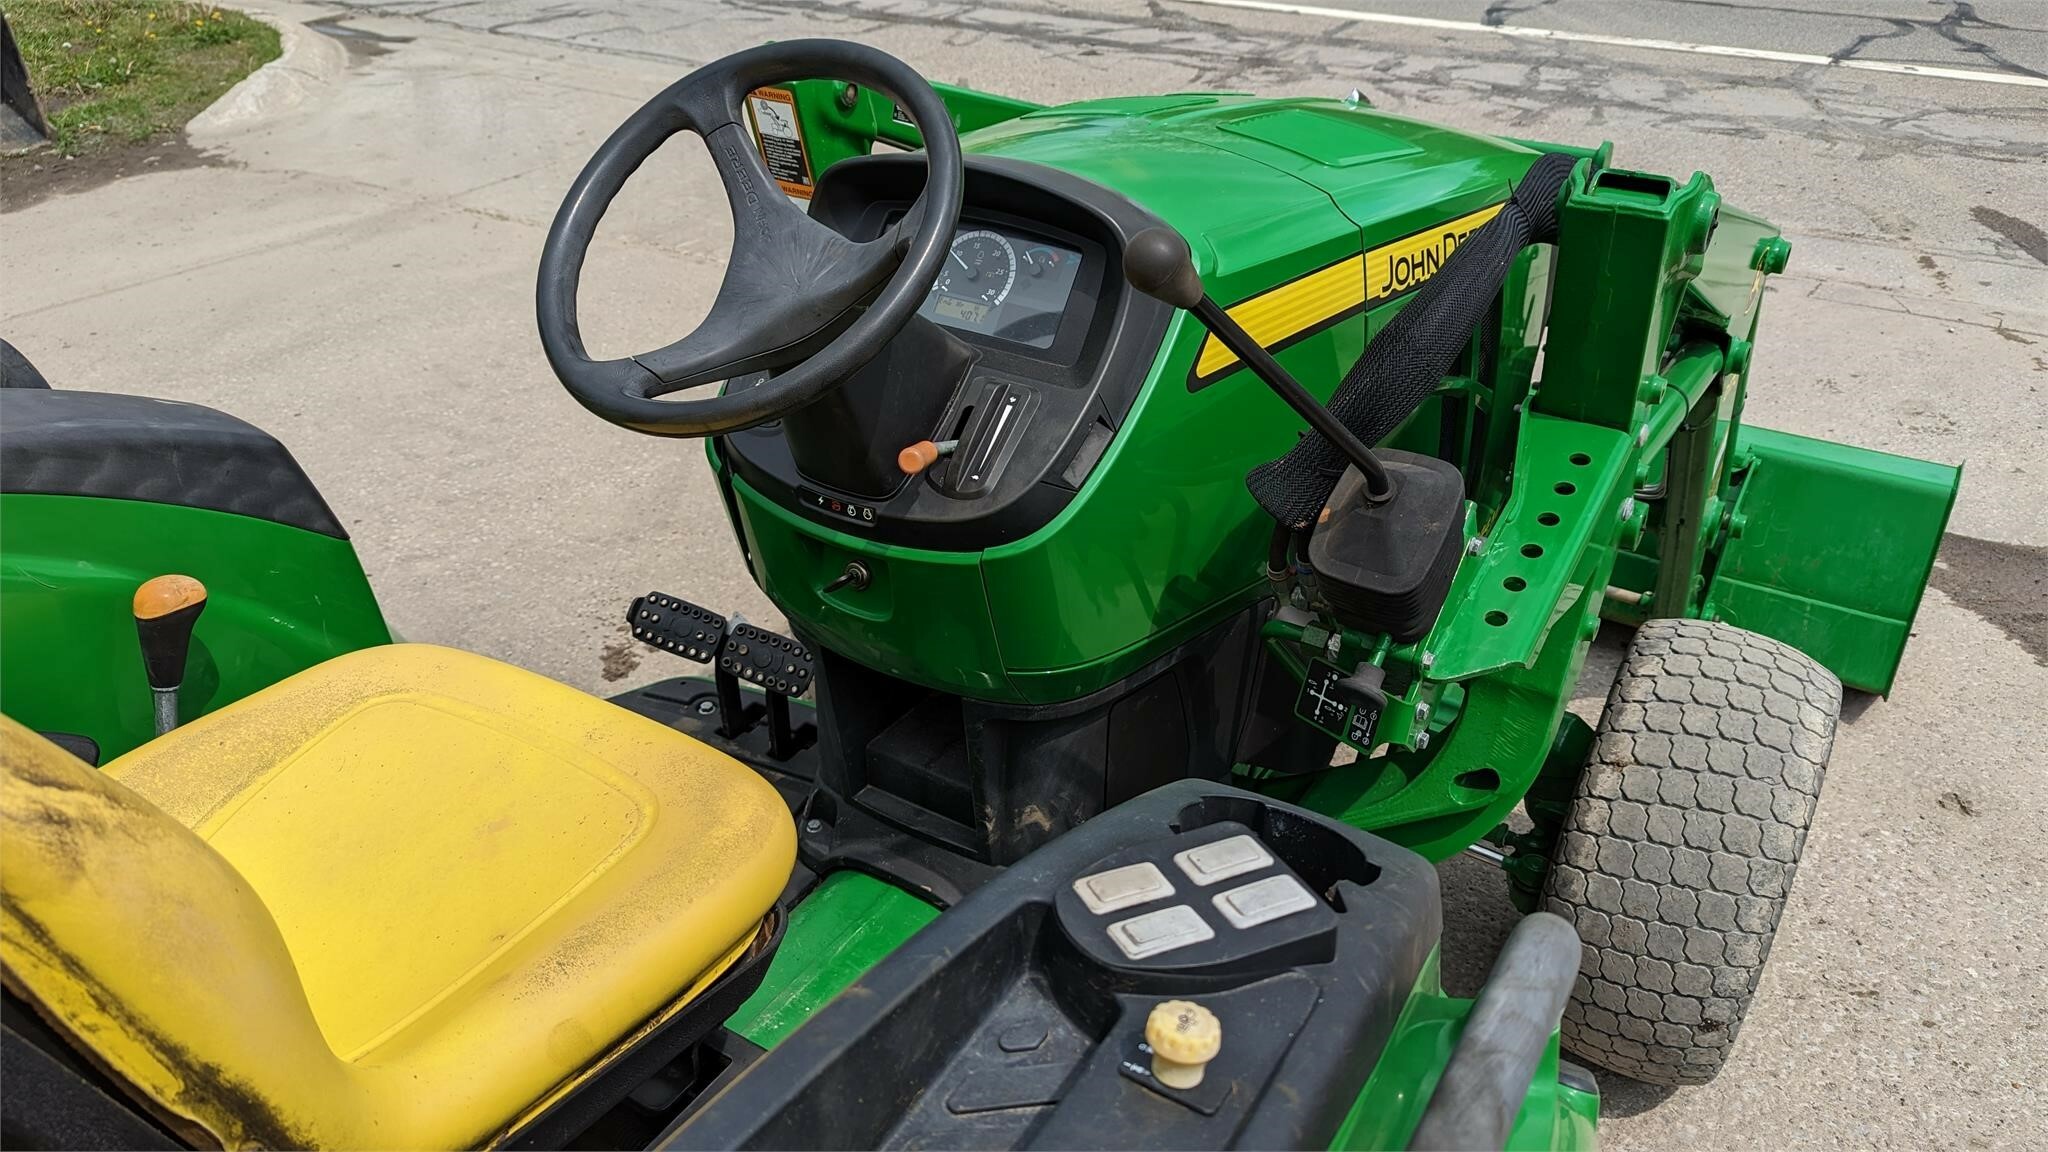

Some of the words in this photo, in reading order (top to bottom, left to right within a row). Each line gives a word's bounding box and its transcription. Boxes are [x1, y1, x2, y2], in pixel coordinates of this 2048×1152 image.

[758, 90, 791, 102] WARNING
[724, 145, 760, 207] DEERE
[1382, 244, 1440, 292] JOHN
